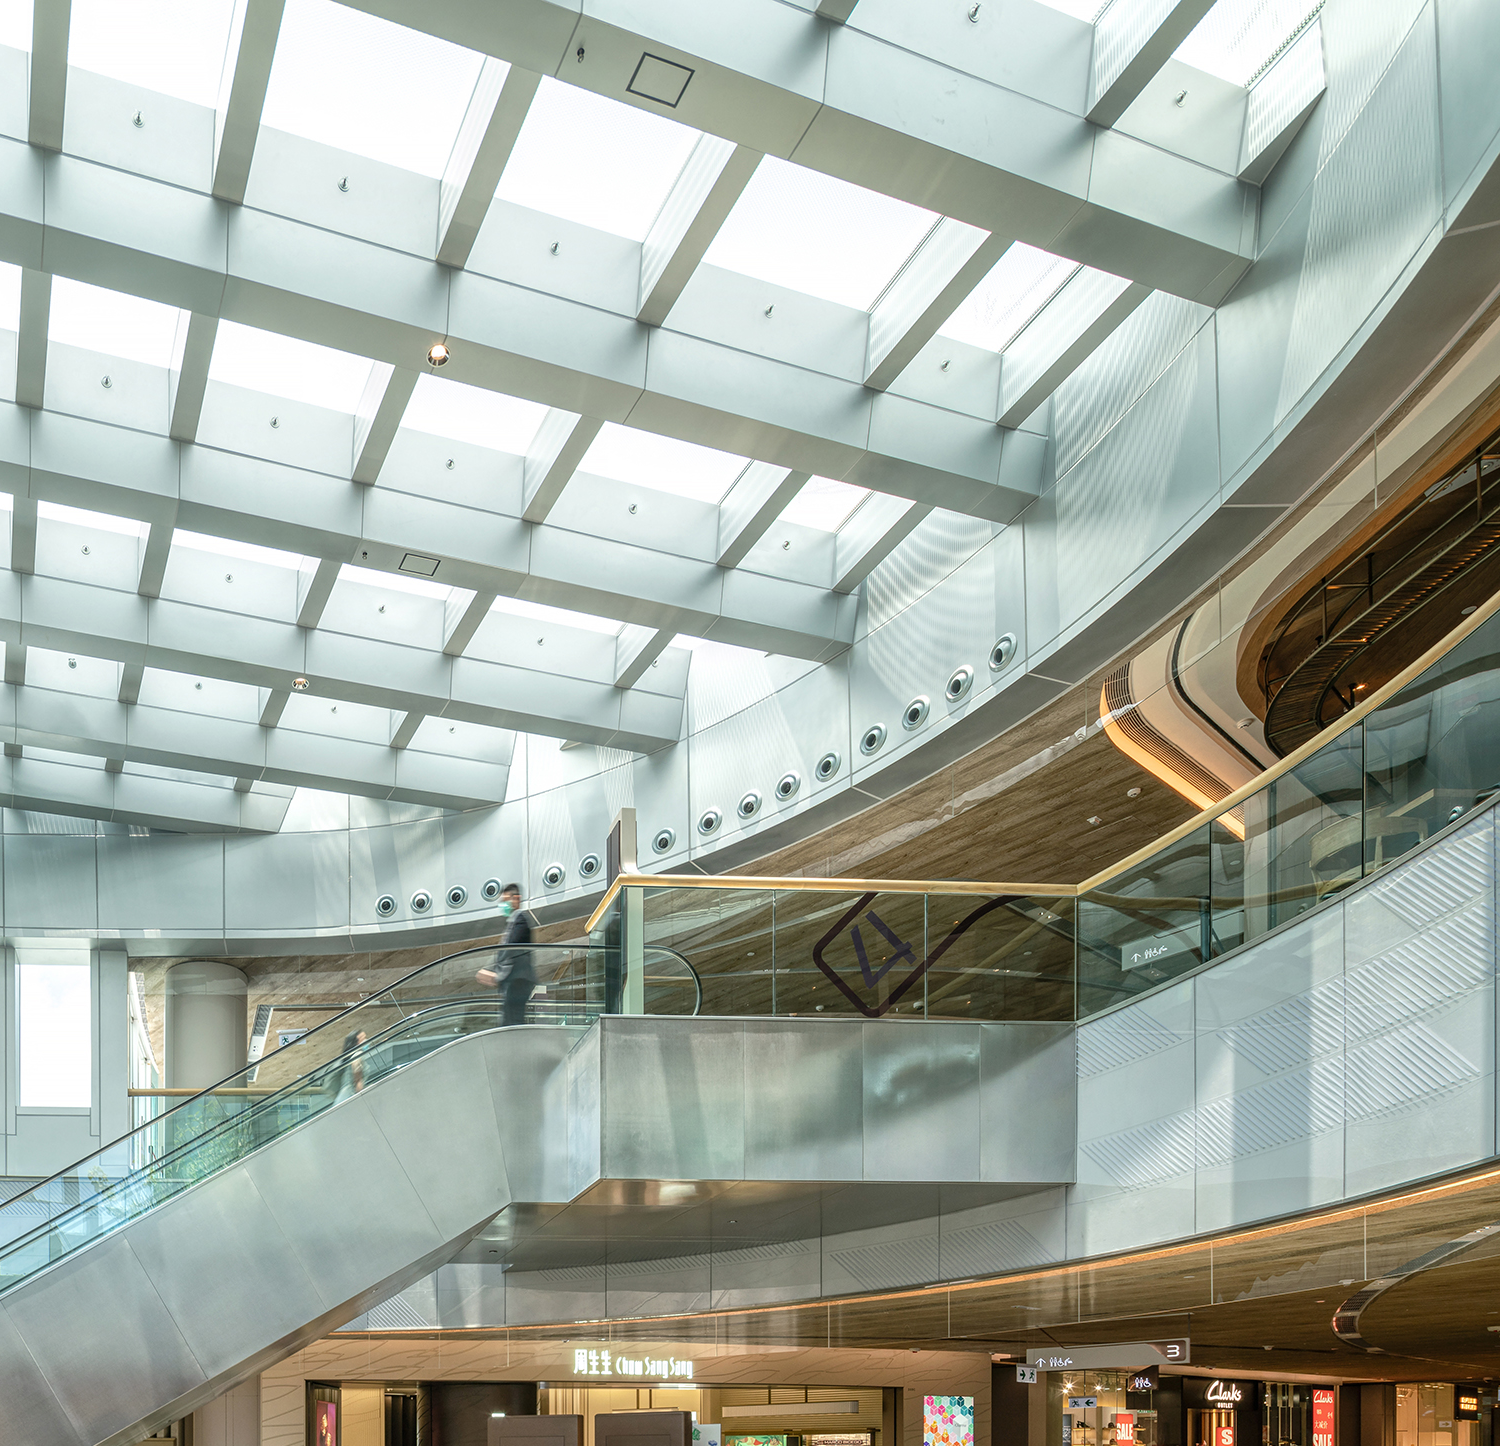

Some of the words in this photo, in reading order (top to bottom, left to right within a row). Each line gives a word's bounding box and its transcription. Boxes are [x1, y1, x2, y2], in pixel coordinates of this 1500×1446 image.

[1167, 1345, 1180, 1358] 3
[573, 1349, 613, 1375] 周生生
[1207, 1380, 1242, 1401] Clarks
[1314, 1391, 1333, 1403] Clarks
[1116, 1423, 1133, 1440] SALE
